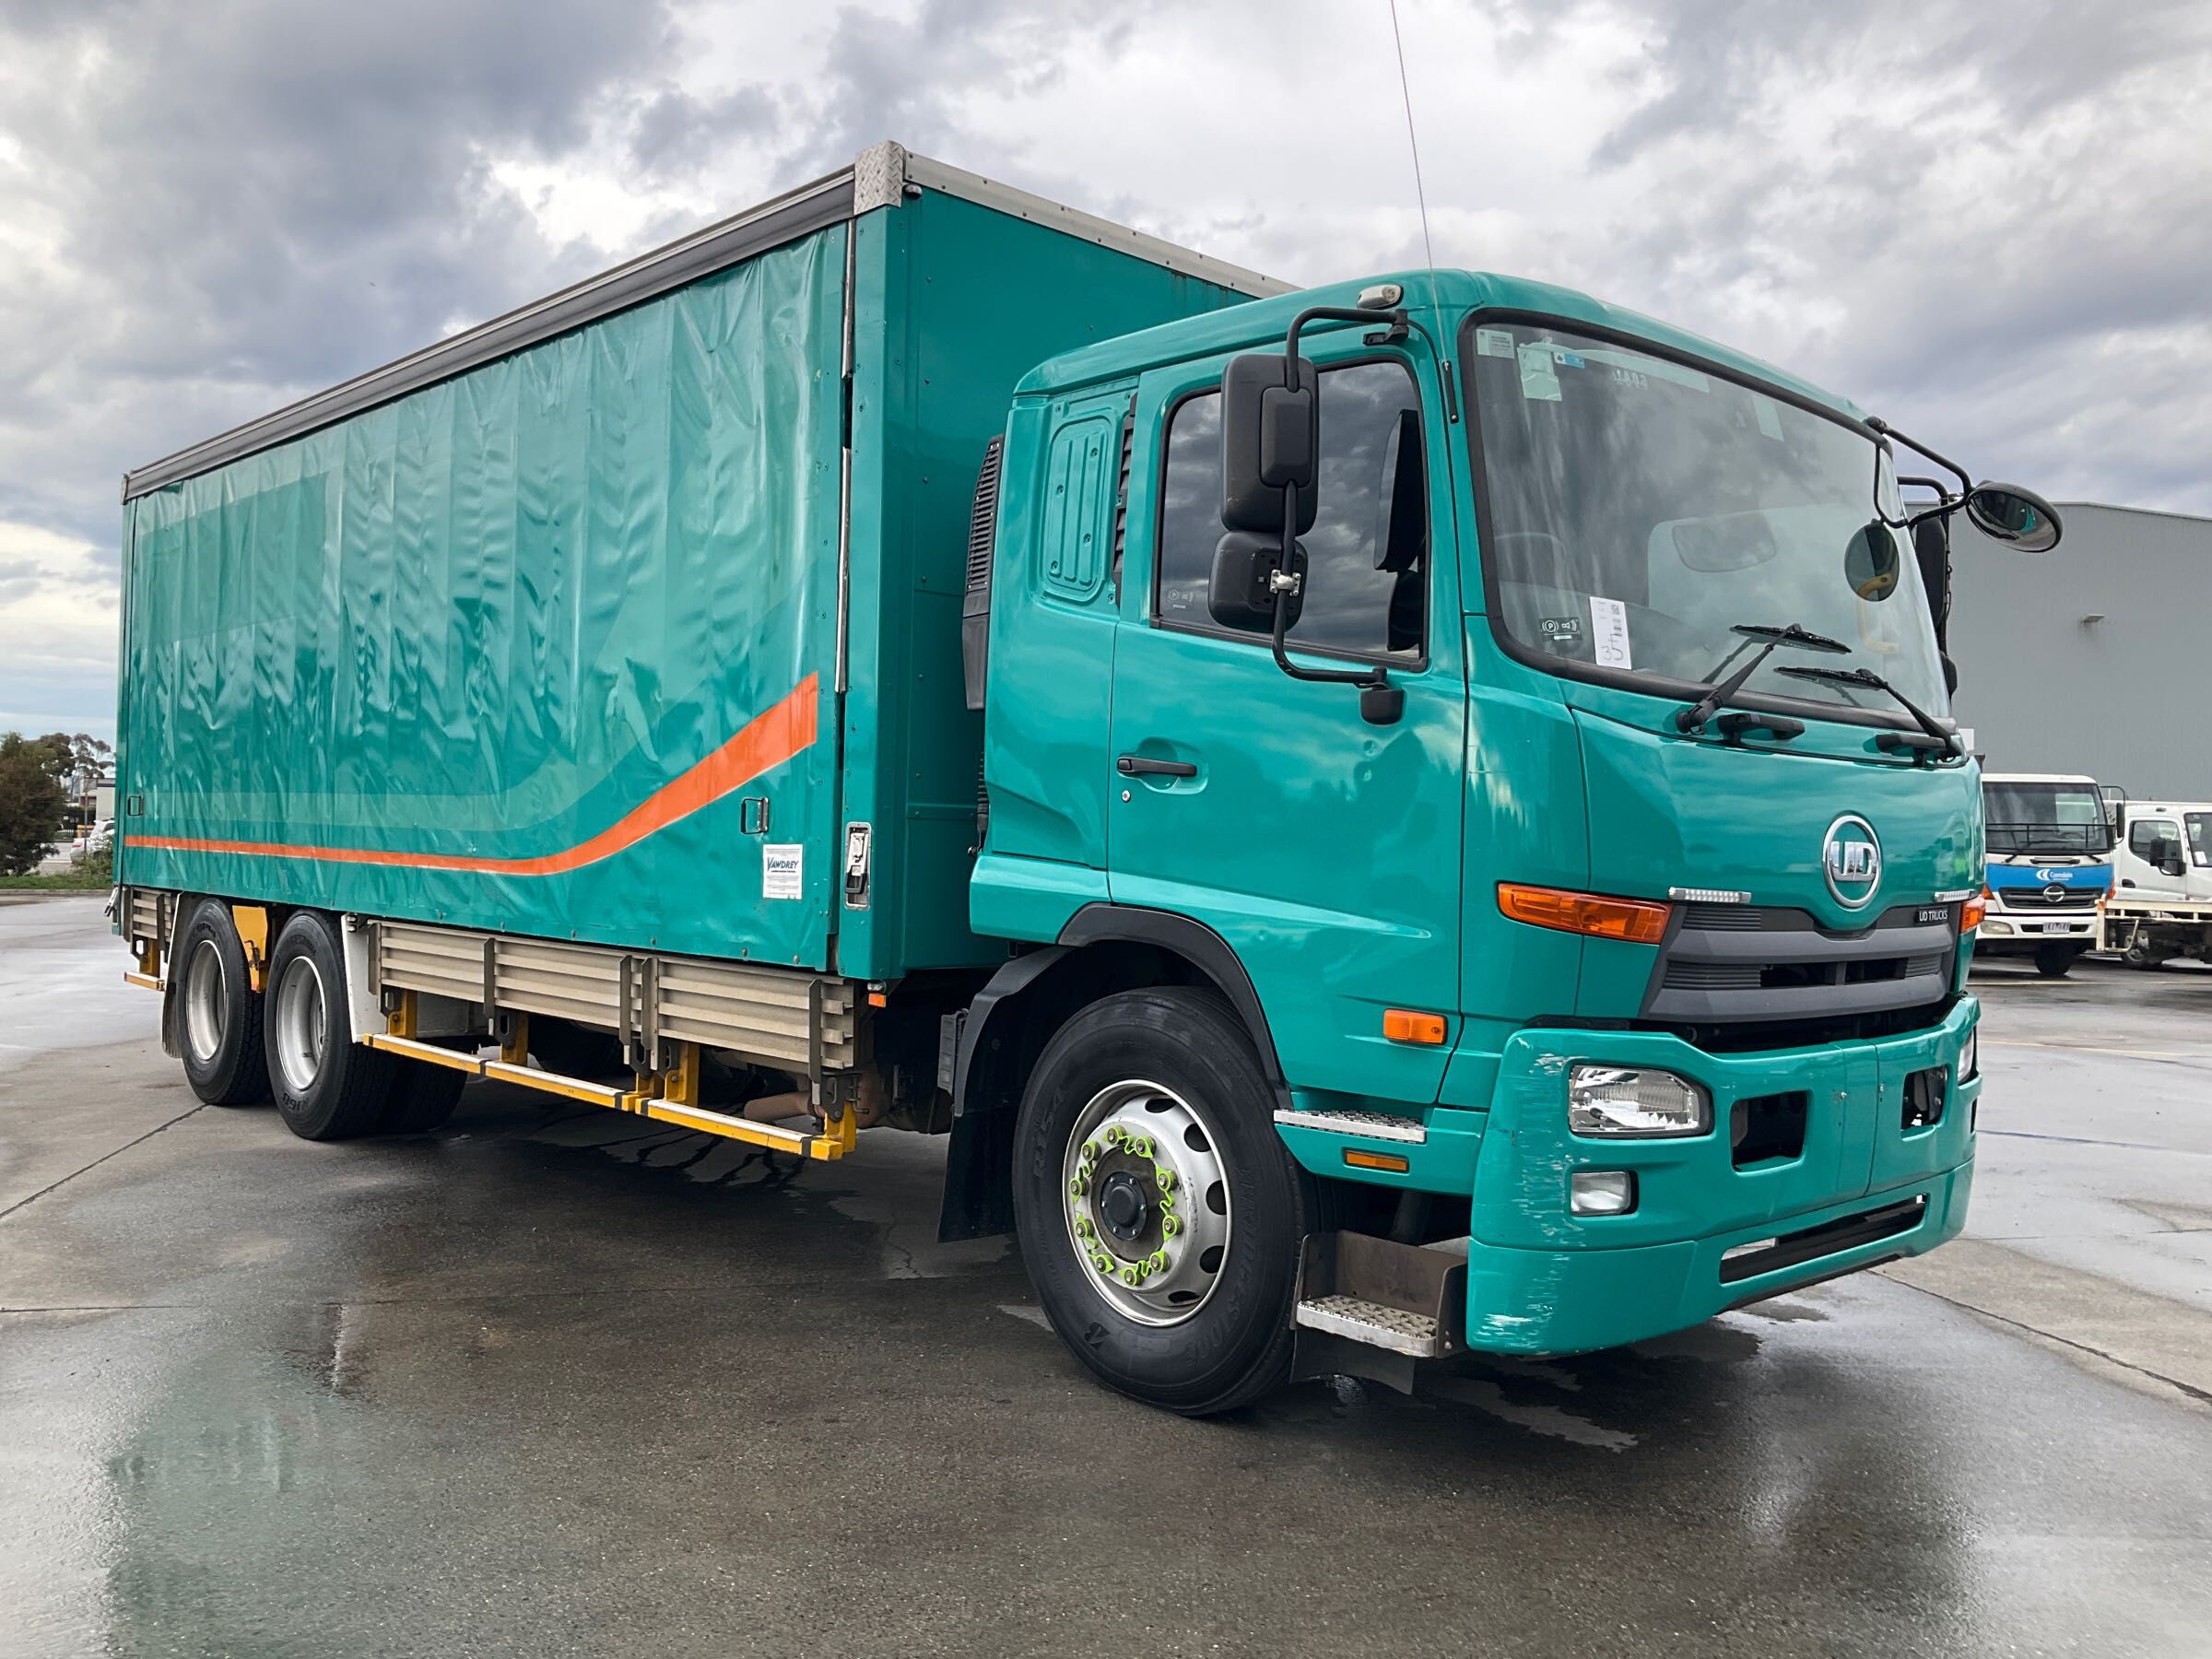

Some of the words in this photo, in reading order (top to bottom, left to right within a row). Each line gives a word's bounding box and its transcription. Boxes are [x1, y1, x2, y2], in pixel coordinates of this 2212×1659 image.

[767, 857, 799, 870] VAWDREY
[1829, 841, 1877, 881] UD
[1919, 911, 1928, 922] UD
[1928, 910, 1948, 922] TRUCKS
